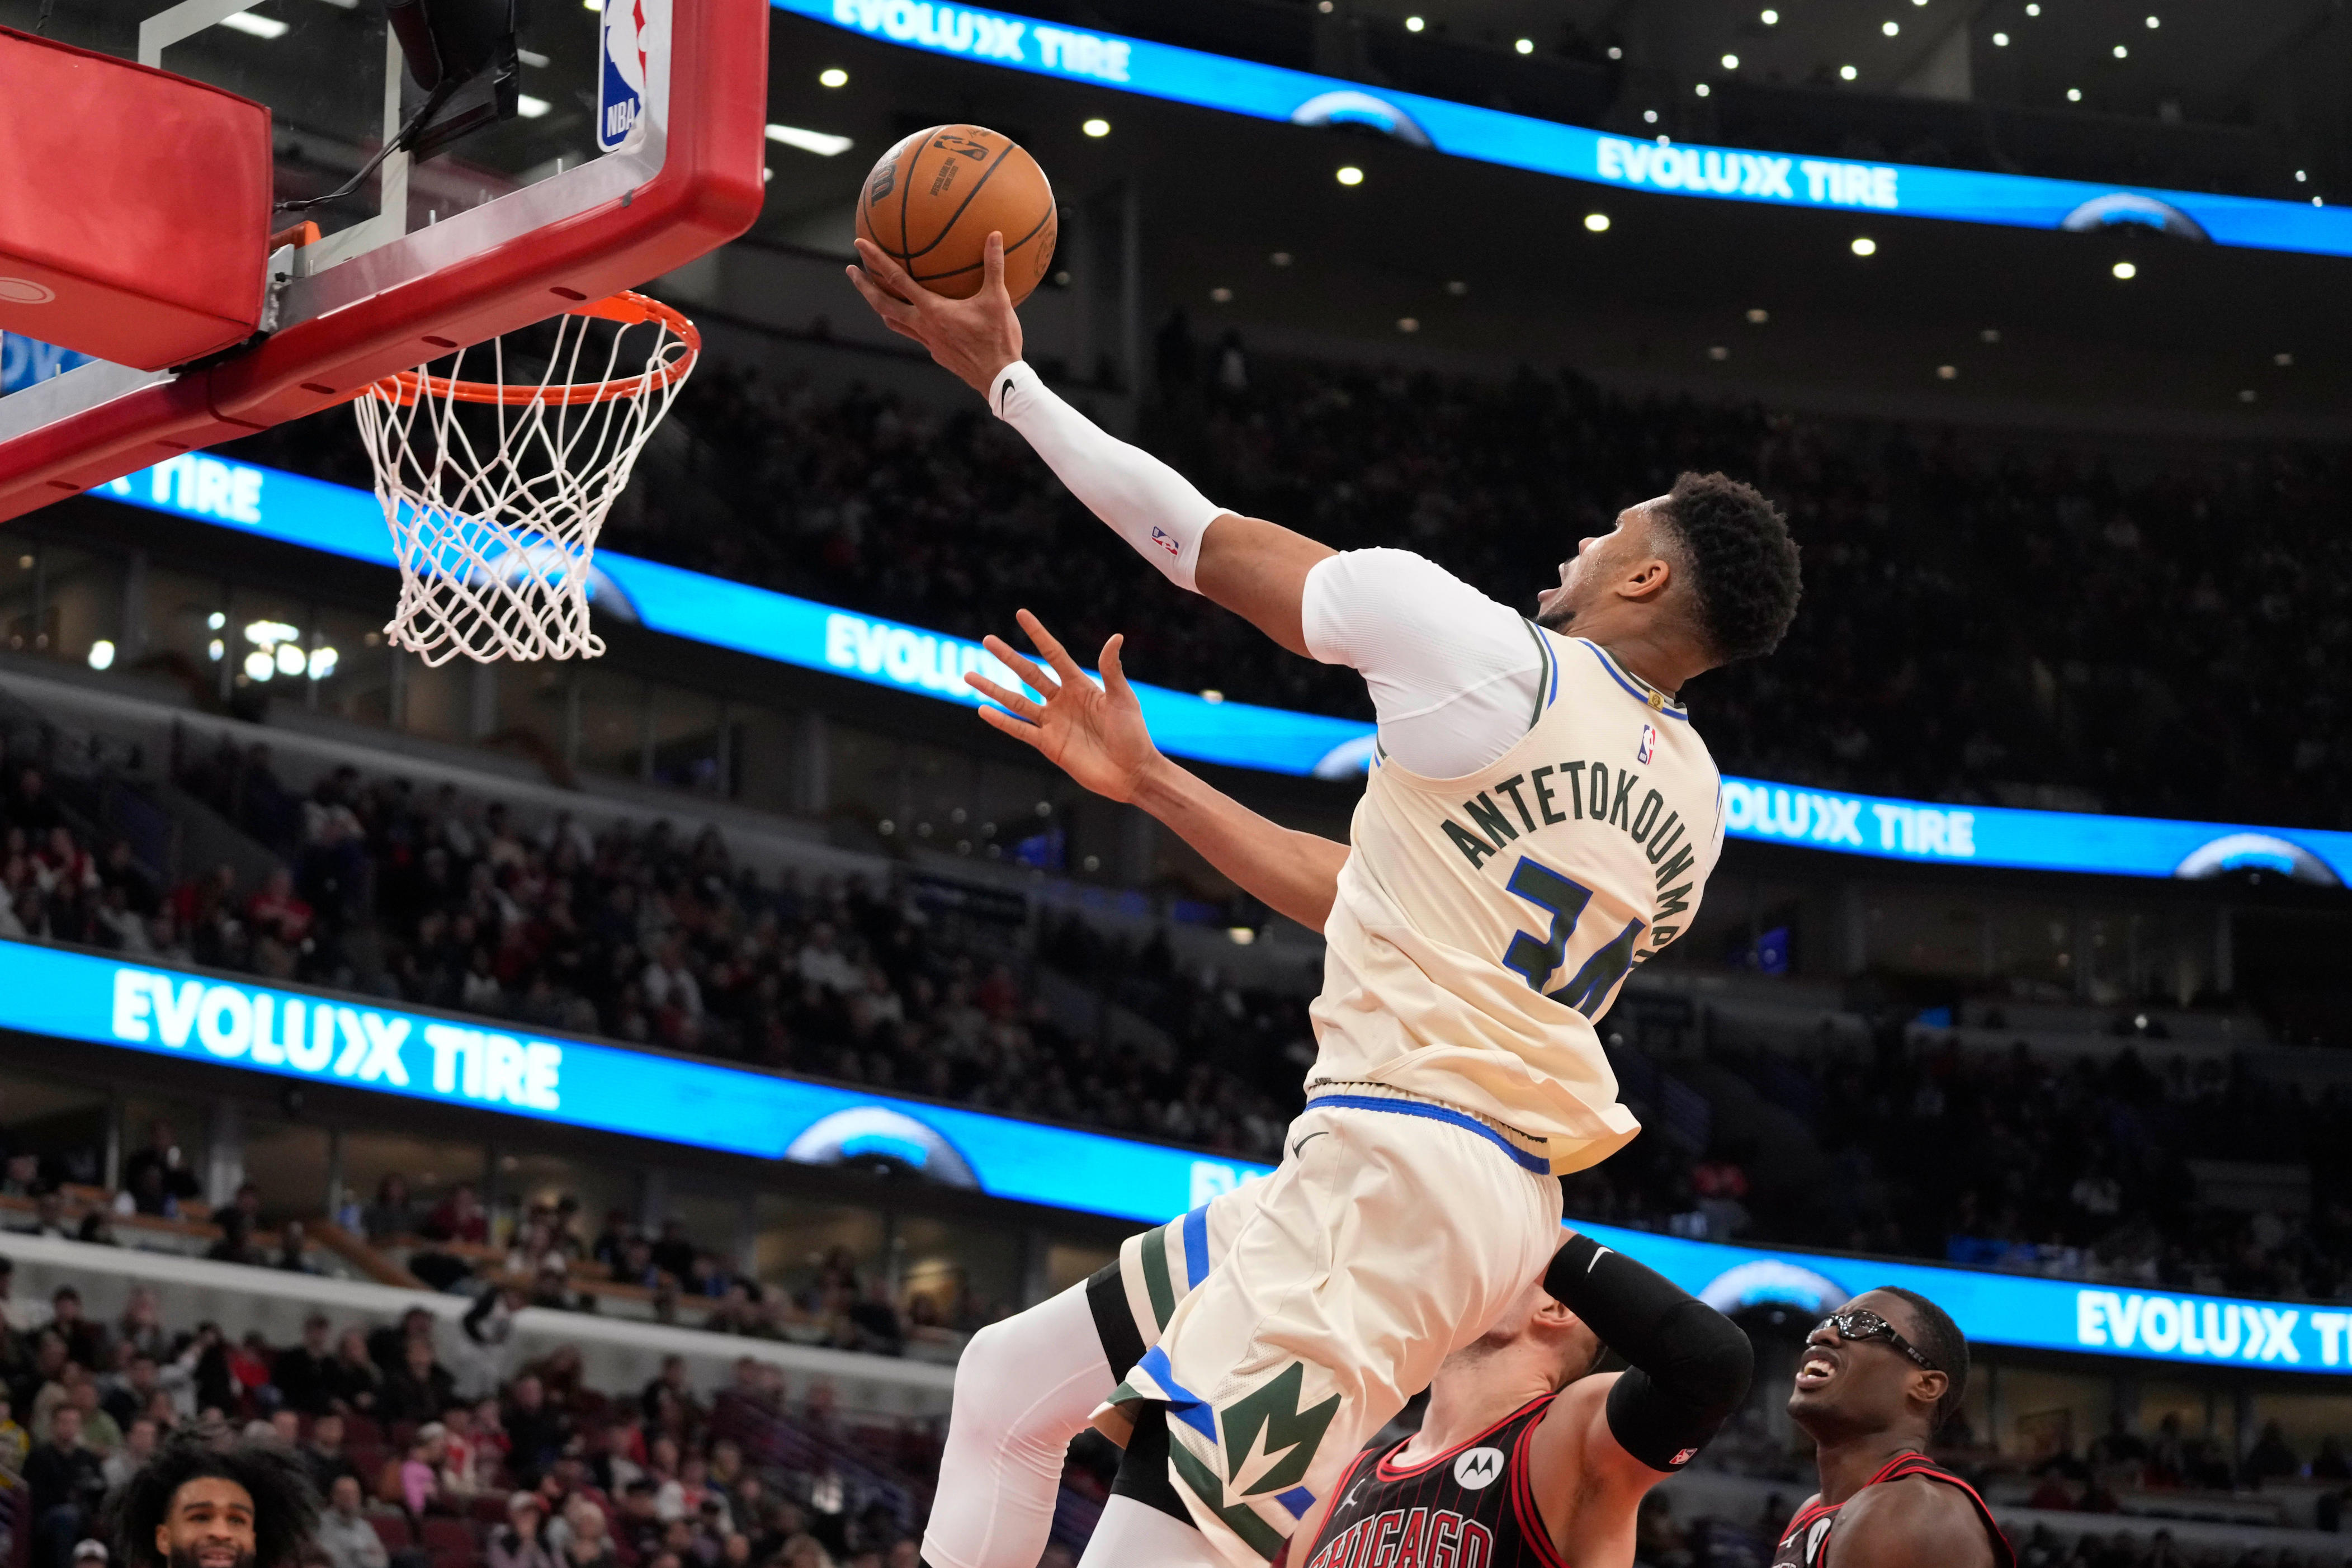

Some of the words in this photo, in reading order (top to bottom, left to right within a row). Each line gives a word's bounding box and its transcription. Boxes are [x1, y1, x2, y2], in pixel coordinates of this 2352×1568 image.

[1034, 26, 1131, 82] TIRE
[607, 97, 635, 138] NBA
[1801, 159, 1899, 209] TIRE
[152, 452, 263, 524] TIRE
[1872, 803, 1976, 857] TIRE
[1502, 855, 1647, 1020] 34
[423, 1023, 563, 1112] TIRE
